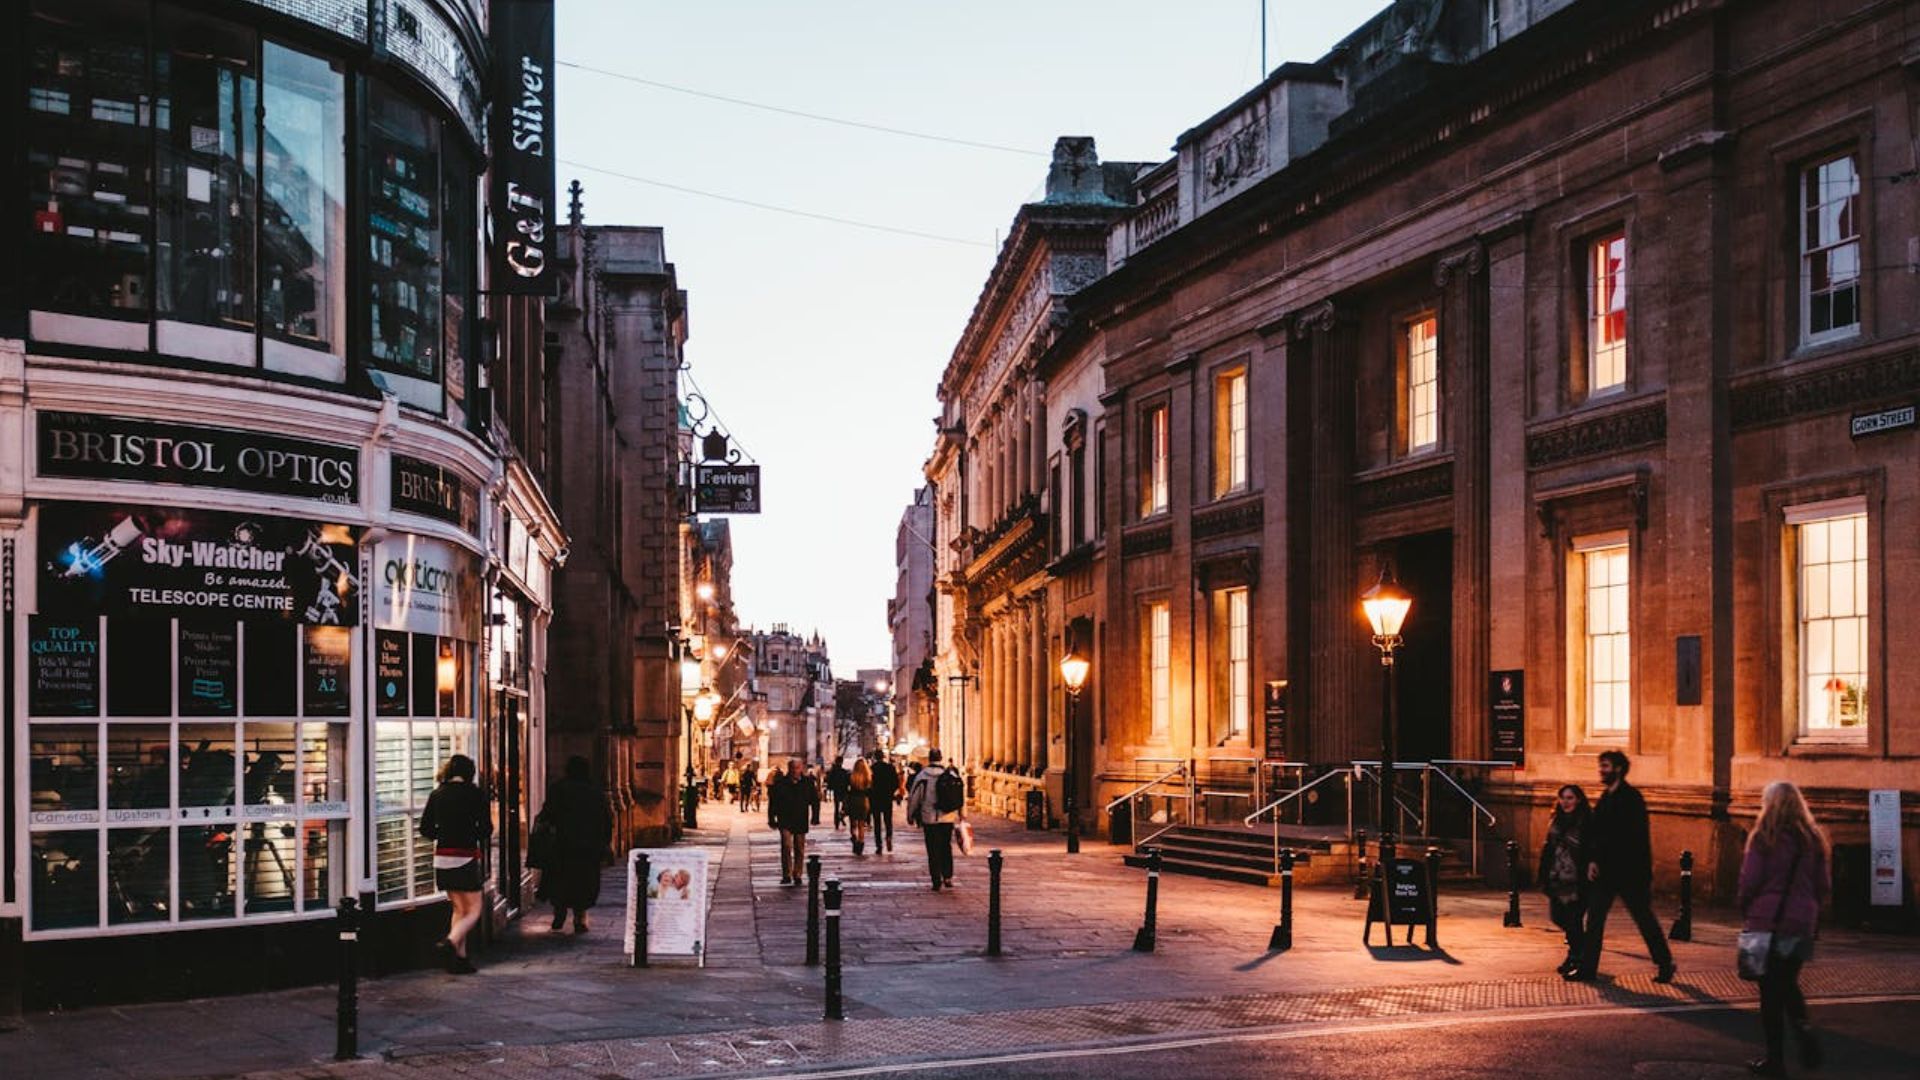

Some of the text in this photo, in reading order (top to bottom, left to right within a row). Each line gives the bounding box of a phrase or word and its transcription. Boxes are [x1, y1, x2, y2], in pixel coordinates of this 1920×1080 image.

[507, 56, 544, 277] G&T Silver
[1880, 410, 1912, 426] STREET
[50, 429, 353, 489] BRISTOL OPTICS
[401, 470, 457, 511] BRISTOL
[141, 537, 286, 572] Sky-Watcher
[204, 572, 292, 590] Be amazed.
[384, 557, 457, 593] opticron
[128, 588, 295, 611] TELESCOPE CENTRE
[47, 626, 81, 640] TOP
[31, 640, 98, 654] QUALITY
[317, 678, 337, 692] A2
[35, 811, 94, 824] Cameras
[245, 804, 292, 816] Cameras
